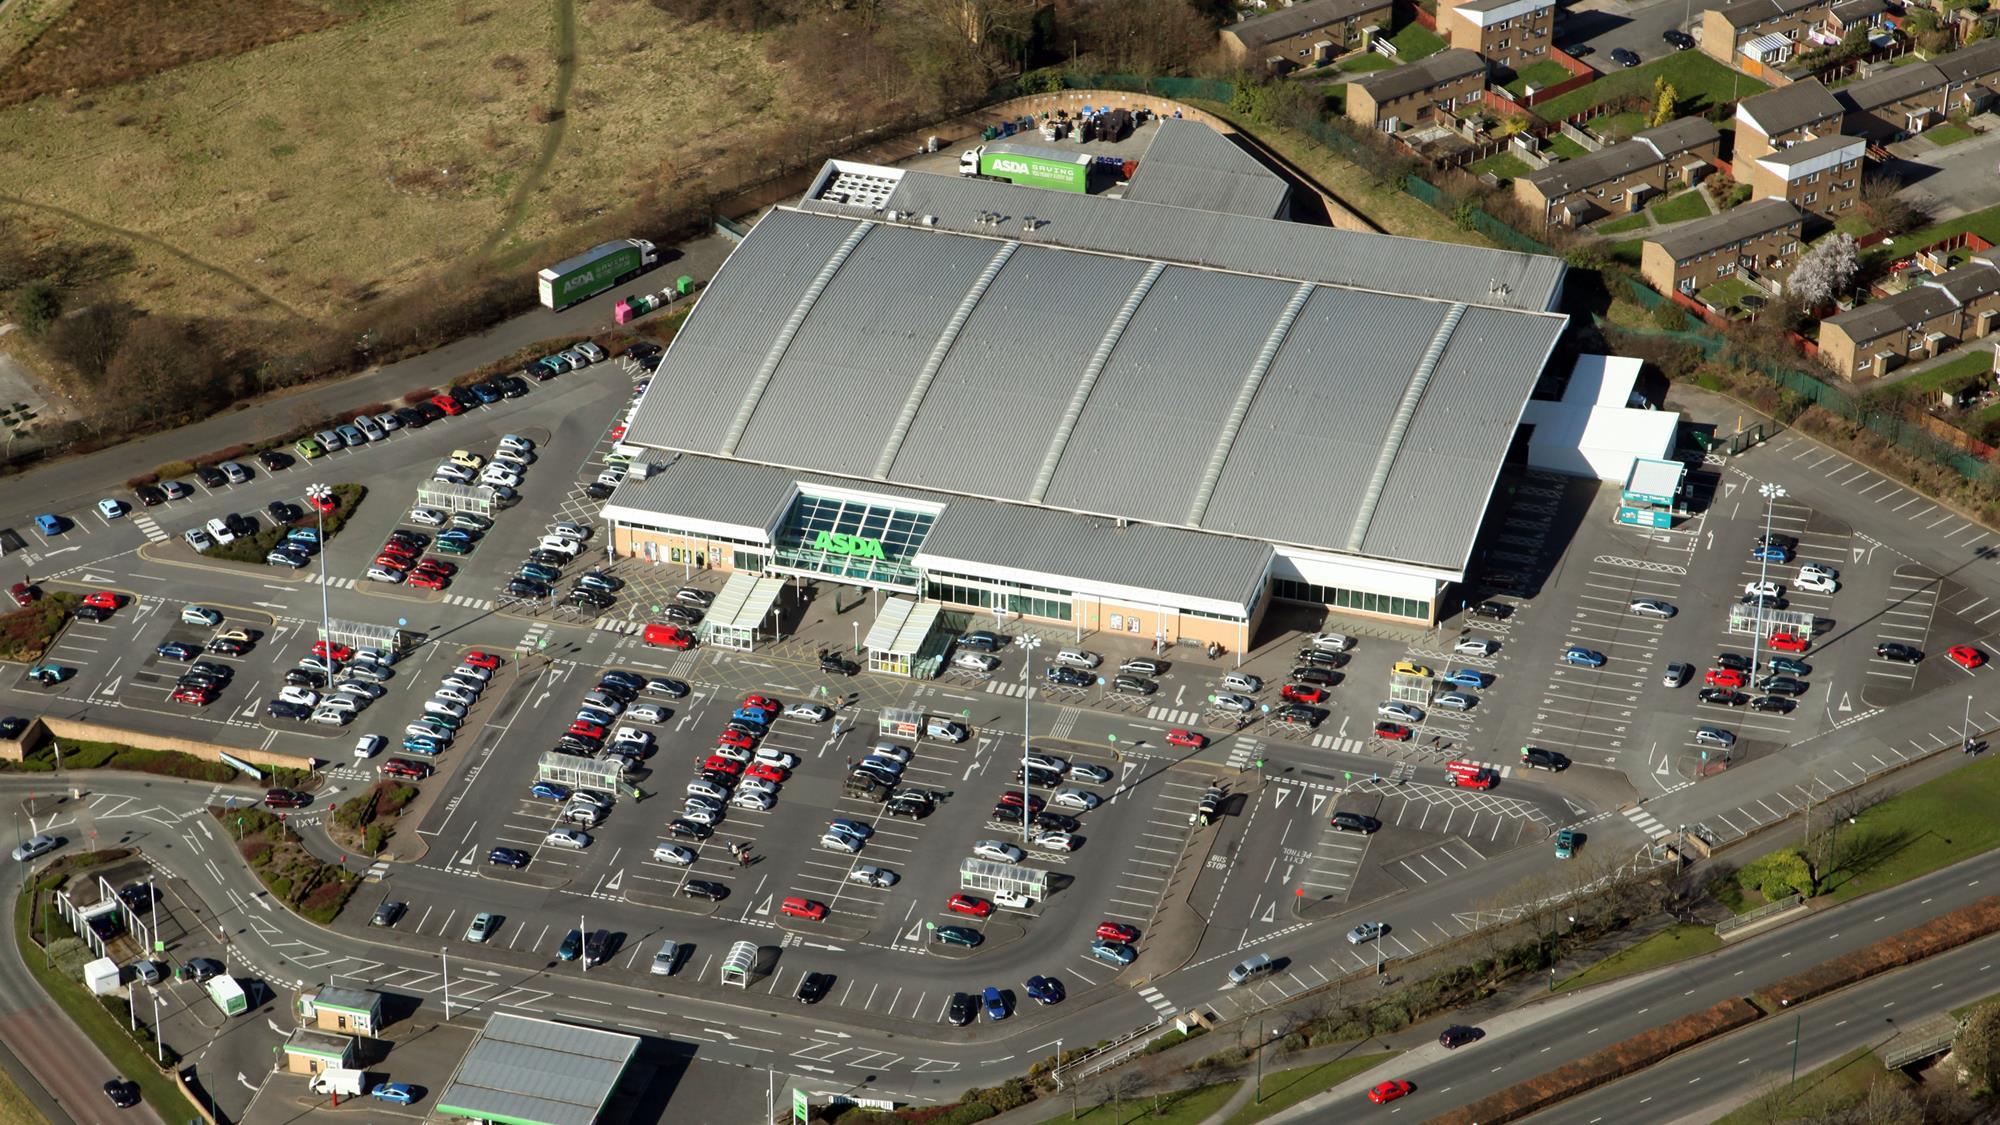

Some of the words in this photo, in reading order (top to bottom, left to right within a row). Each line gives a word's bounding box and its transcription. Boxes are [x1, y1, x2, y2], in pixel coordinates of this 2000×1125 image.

[992, 159, 1030, 175] ASDA
[1031, 165, 1074, 176] SAVING
[563, 271, 595, 294] ASDA
[814, 530, 885, 560] ASDA
[445, 796, 460, 810] TAXI
[464, 766, 480, 782] PICK
[295, 817, 322, 828] TAXI
[1211, 854, 1228, 863] BUS
[1283, 847, 1313, 859] PETROL
[1206, 861, 1227, 870] STOP
[1283, 855, 1304, 865] EXIT
